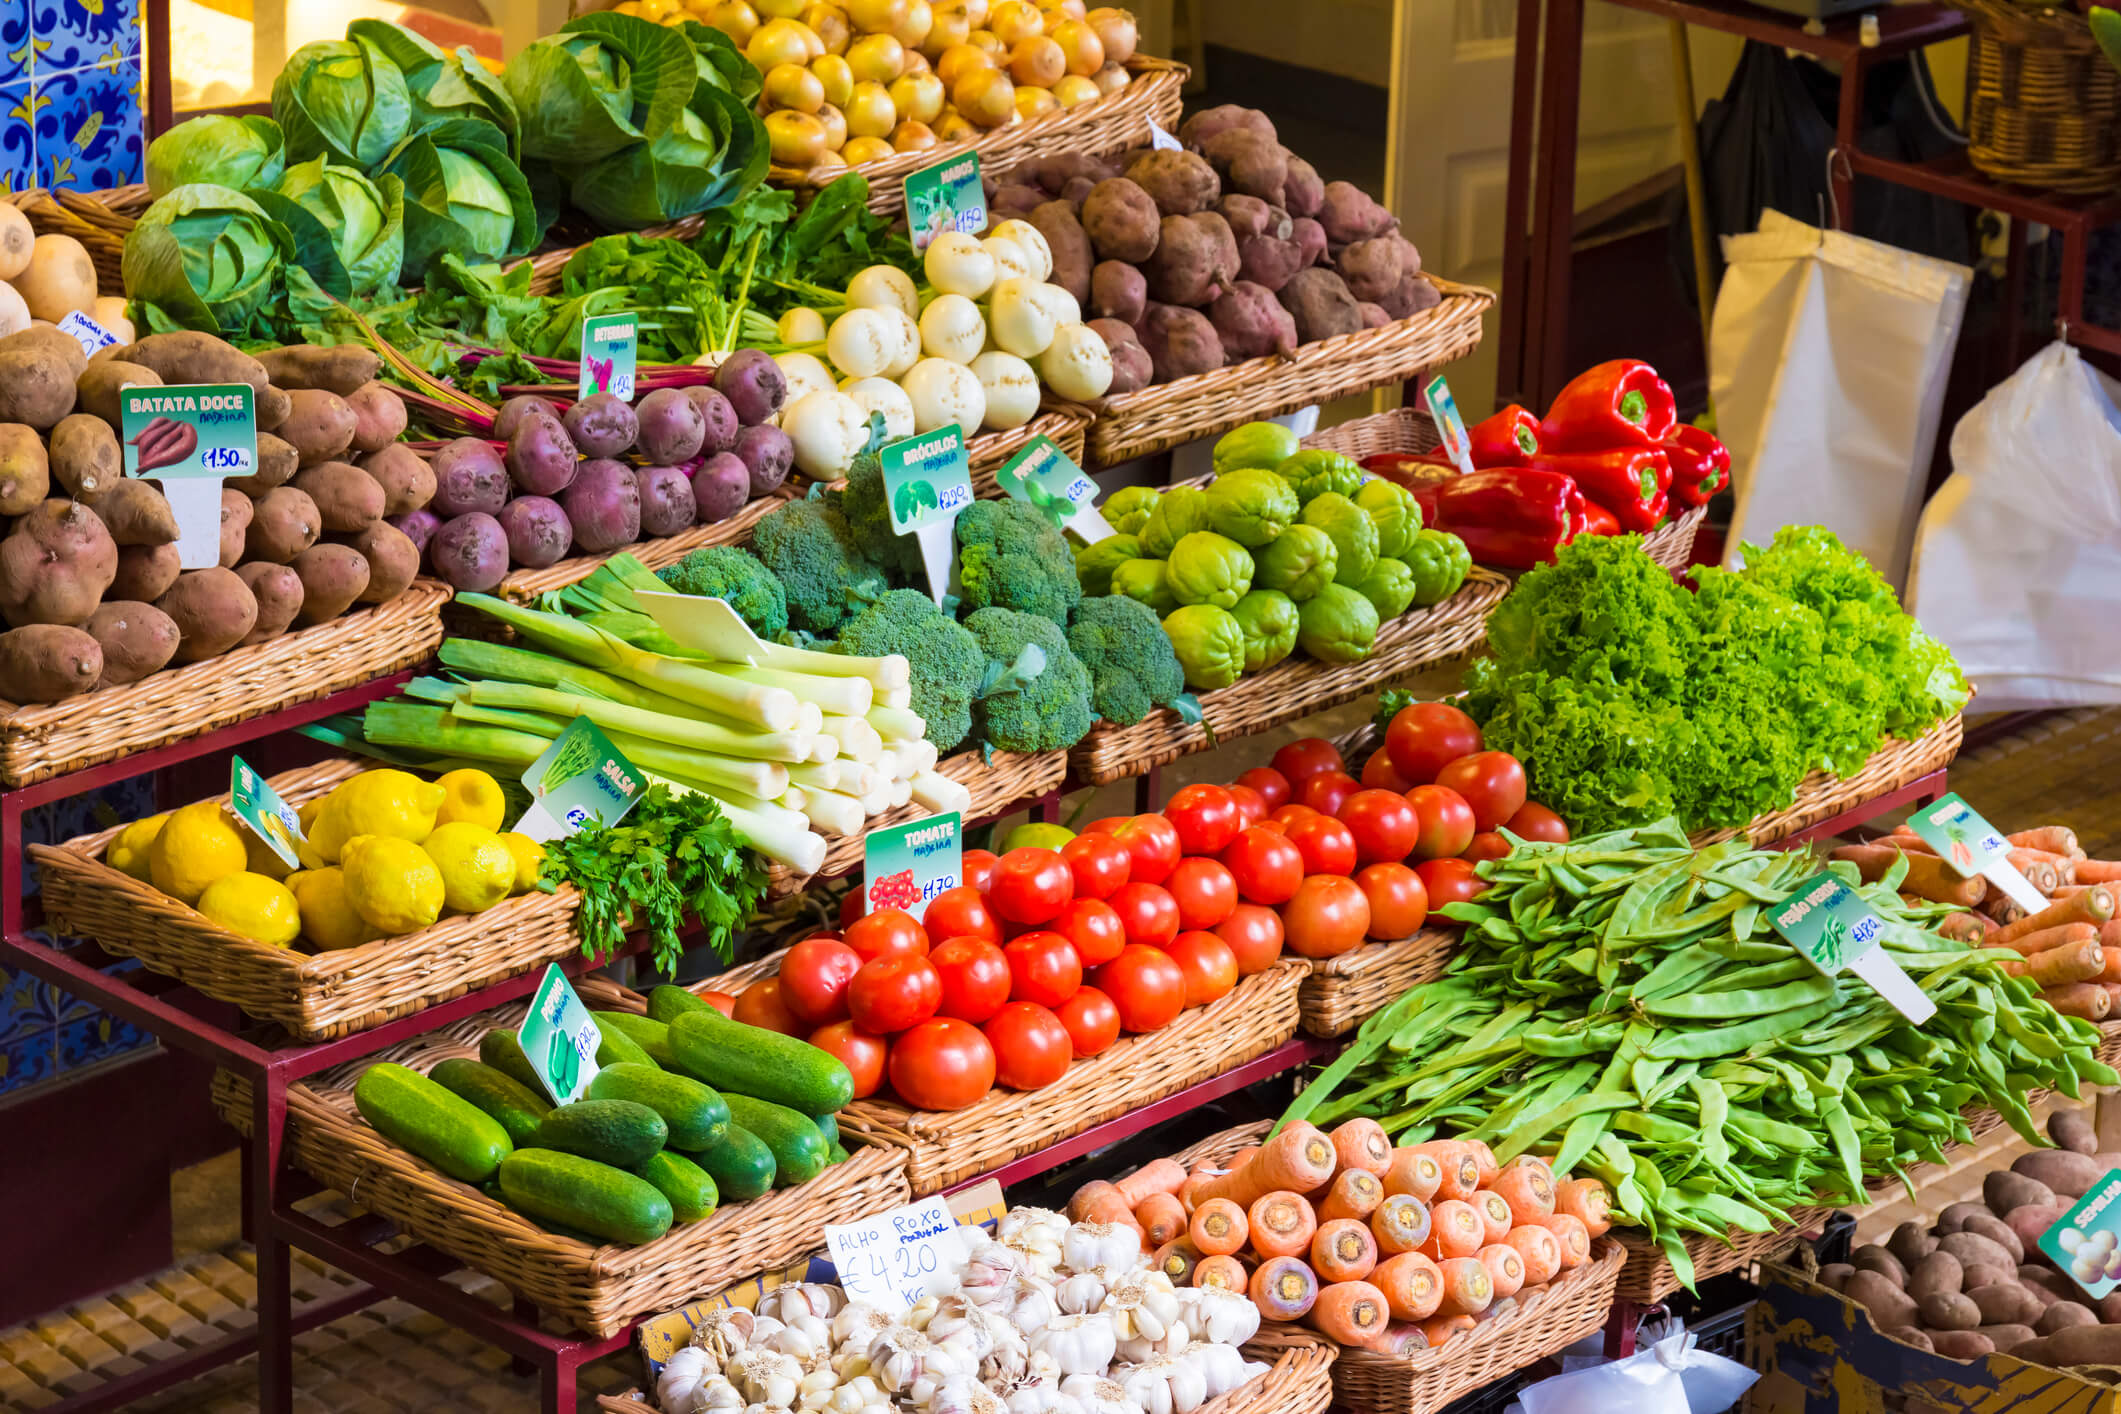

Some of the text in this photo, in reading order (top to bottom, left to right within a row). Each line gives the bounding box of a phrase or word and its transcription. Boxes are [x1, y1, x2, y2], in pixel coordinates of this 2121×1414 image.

[129, 394, 244, 413] BATATA DOCE
[903, 434, 958, 467] BRÓCULOS
[602, 759, 636, 797] SALSA
[904, 821, 954, 848] TOMATE
[1805, 879, 1840, 907] VERDE
[540, 976, 564, 1023] PEPINO
[838, 1209, 941, 1252] ALHO ROXO
[899, 1222, 949, 1245] PORTUGAL
